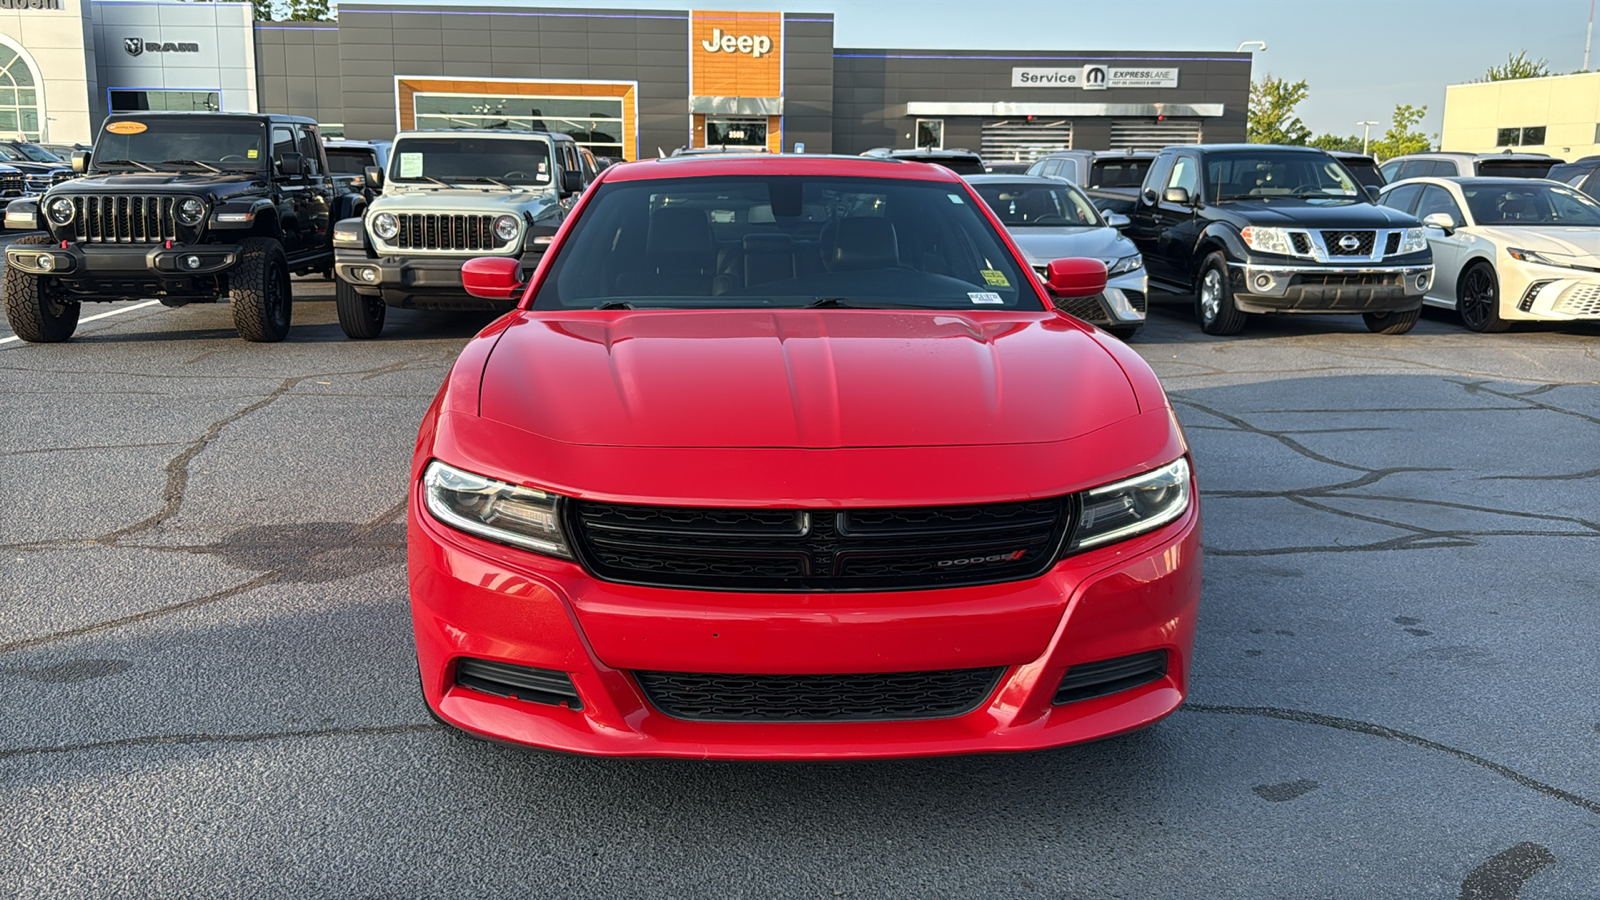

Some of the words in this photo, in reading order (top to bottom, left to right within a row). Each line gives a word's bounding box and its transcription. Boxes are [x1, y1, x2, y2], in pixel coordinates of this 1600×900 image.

[145, 42, 199, 53] RAM
[702, 28, 771, 58] Jeep
[1020, 72, 1076, 83] Service
[937, 553, 1014, 567] DODGE
